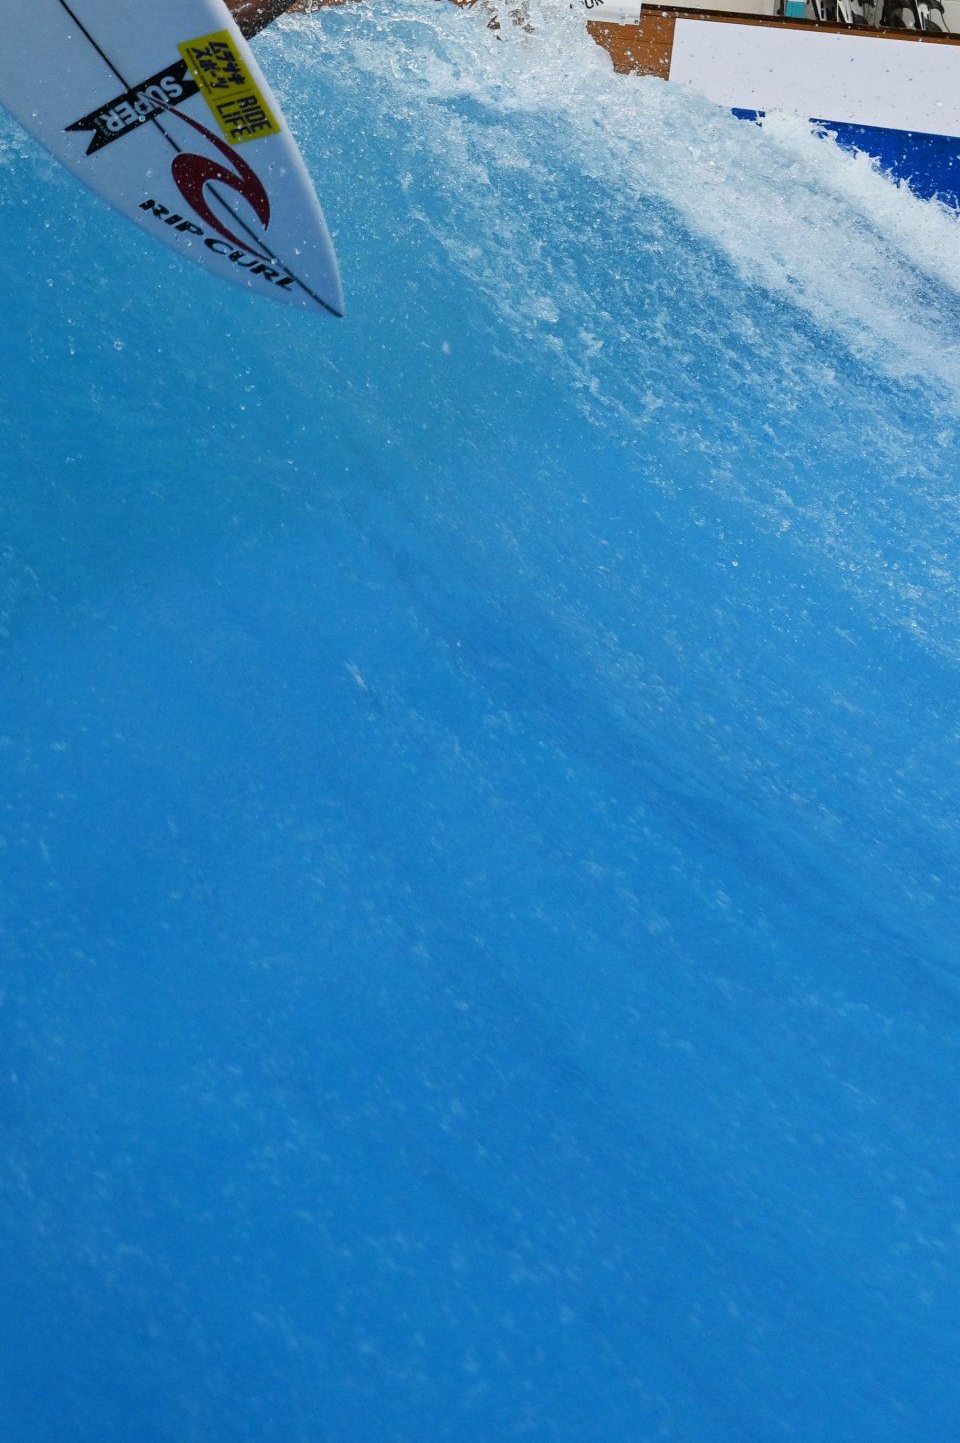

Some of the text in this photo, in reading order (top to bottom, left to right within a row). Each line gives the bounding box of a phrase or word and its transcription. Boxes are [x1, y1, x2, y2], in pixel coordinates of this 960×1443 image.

[101, 76, 183, 133] SUPER
[216, 101, 252, 139] LIFE
[236, 94, 272, 134] RIDE
[139, 199, 297, 291] RIP CURL
